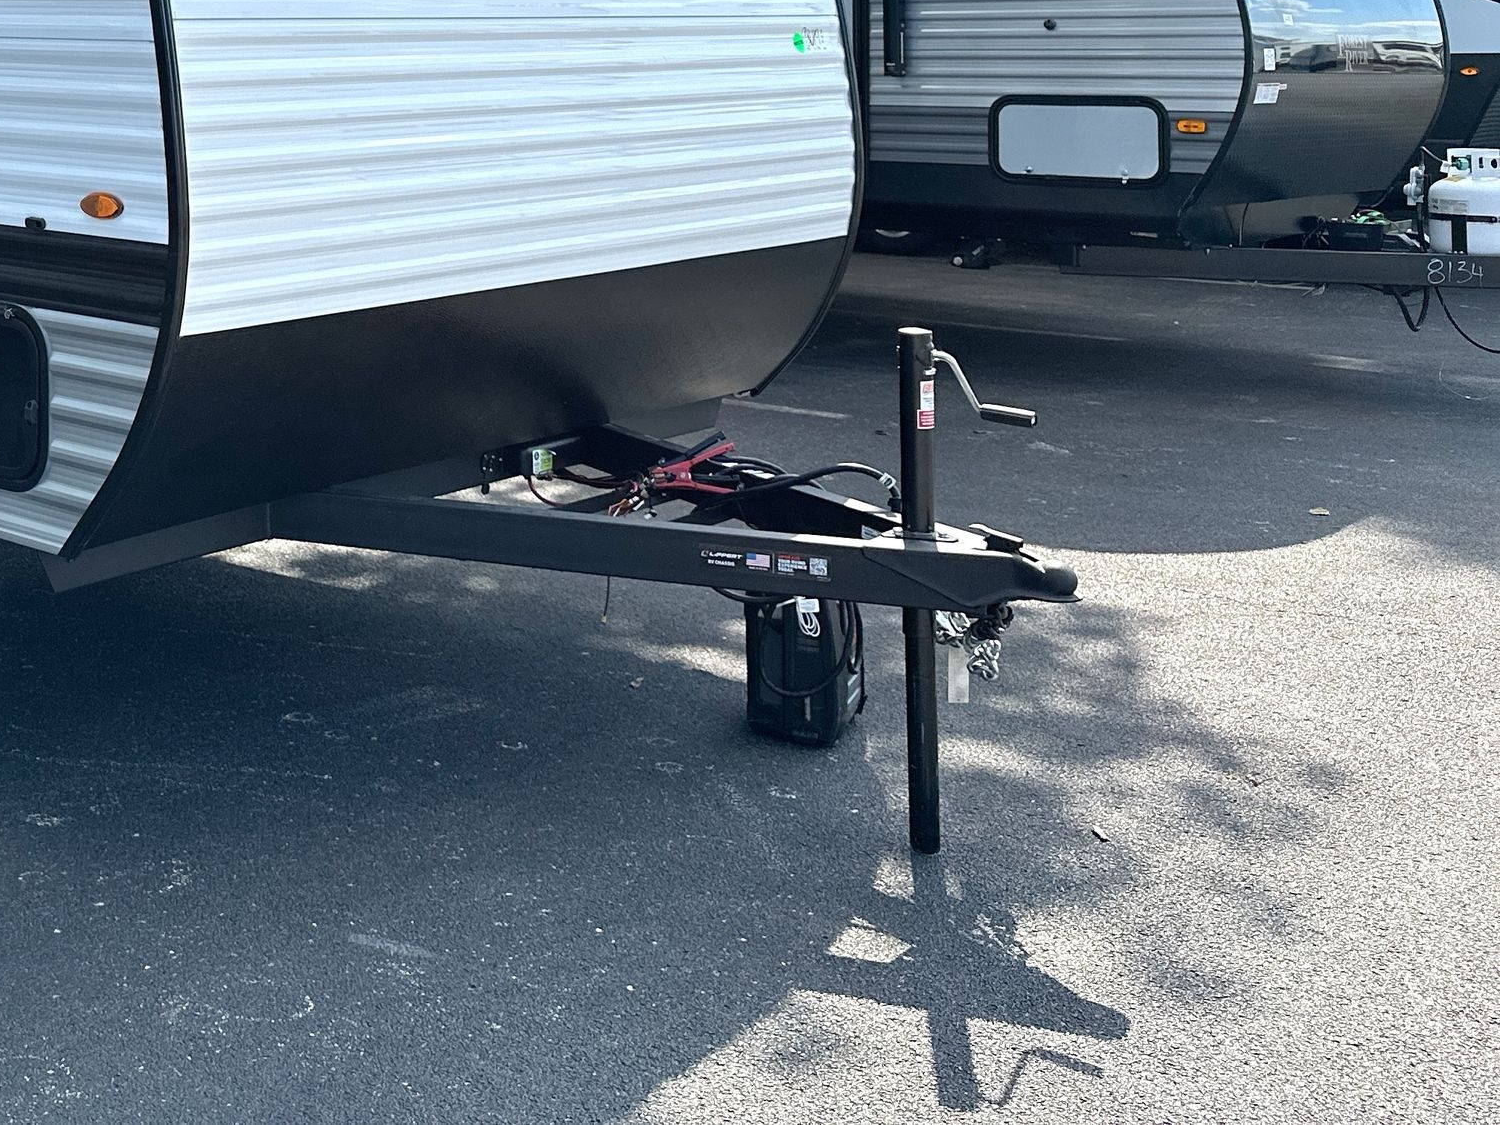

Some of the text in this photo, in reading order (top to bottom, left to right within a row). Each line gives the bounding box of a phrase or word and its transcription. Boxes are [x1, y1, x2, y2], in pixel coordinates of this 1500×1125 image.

[1337, 34, 1368, 57] FOREST
[1344, 49, 1369, 72] RIVER
[1427, 258, 1484, 286] 8134
